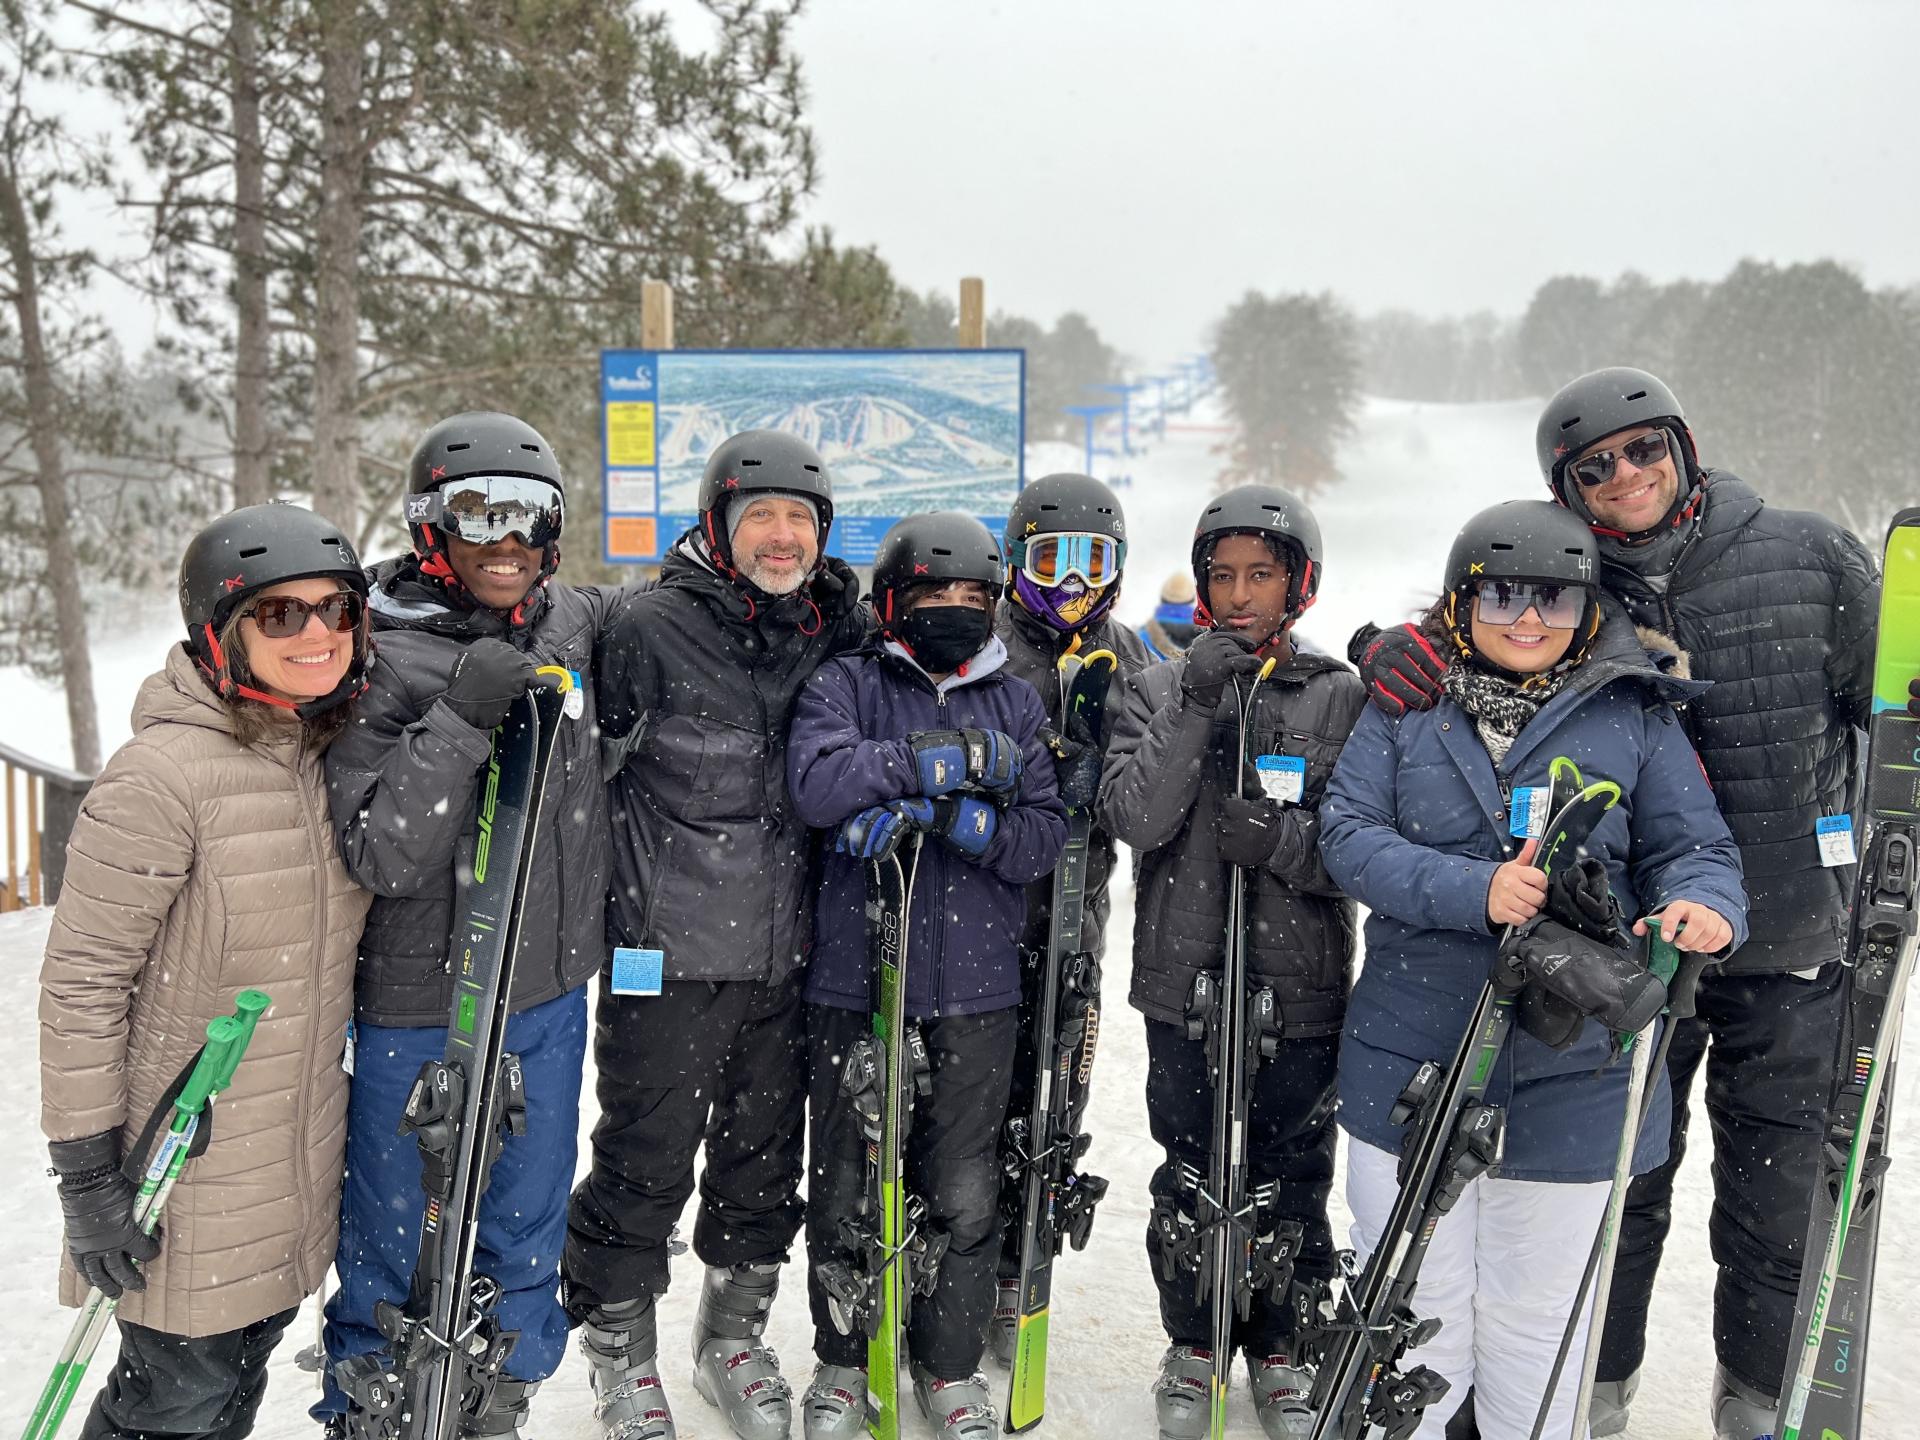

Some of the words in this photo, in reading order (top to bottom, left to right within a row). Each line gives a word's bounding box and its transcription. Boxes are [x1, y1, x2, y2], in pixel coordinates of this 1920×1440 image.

[1272, 512, 1290, 528] 26
[1578, 556, 1592, 580] 49
[880, 910, 898, 984] eRise
[1810, 1271, 1831, 1330] SCOTT
[1833, 1338, 1851, 1374] 170
